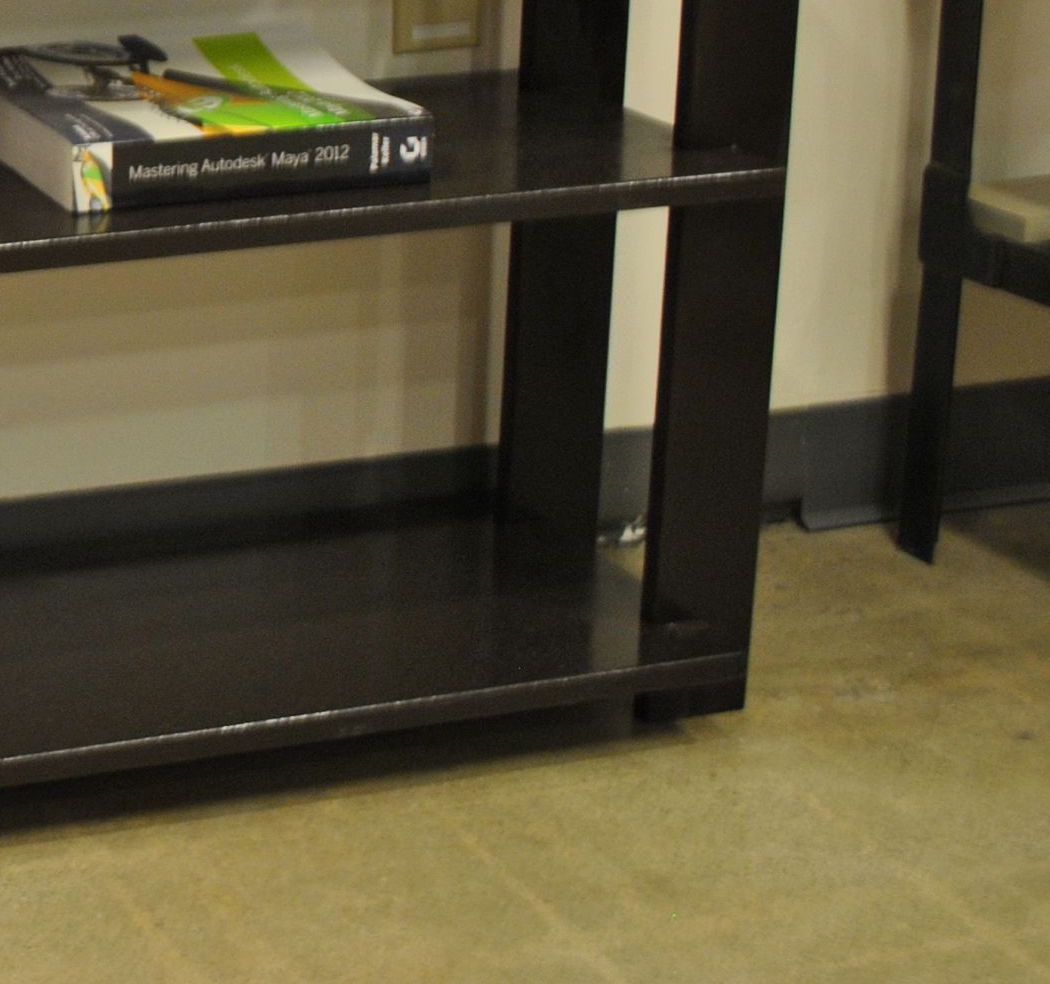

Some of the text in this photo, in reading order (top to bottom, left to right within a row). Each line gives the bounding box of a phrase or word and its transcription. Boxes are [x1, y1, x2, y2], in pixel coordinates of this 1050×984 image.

[129, 144, 350, 180] Mastering Autodesk Maya 2012
